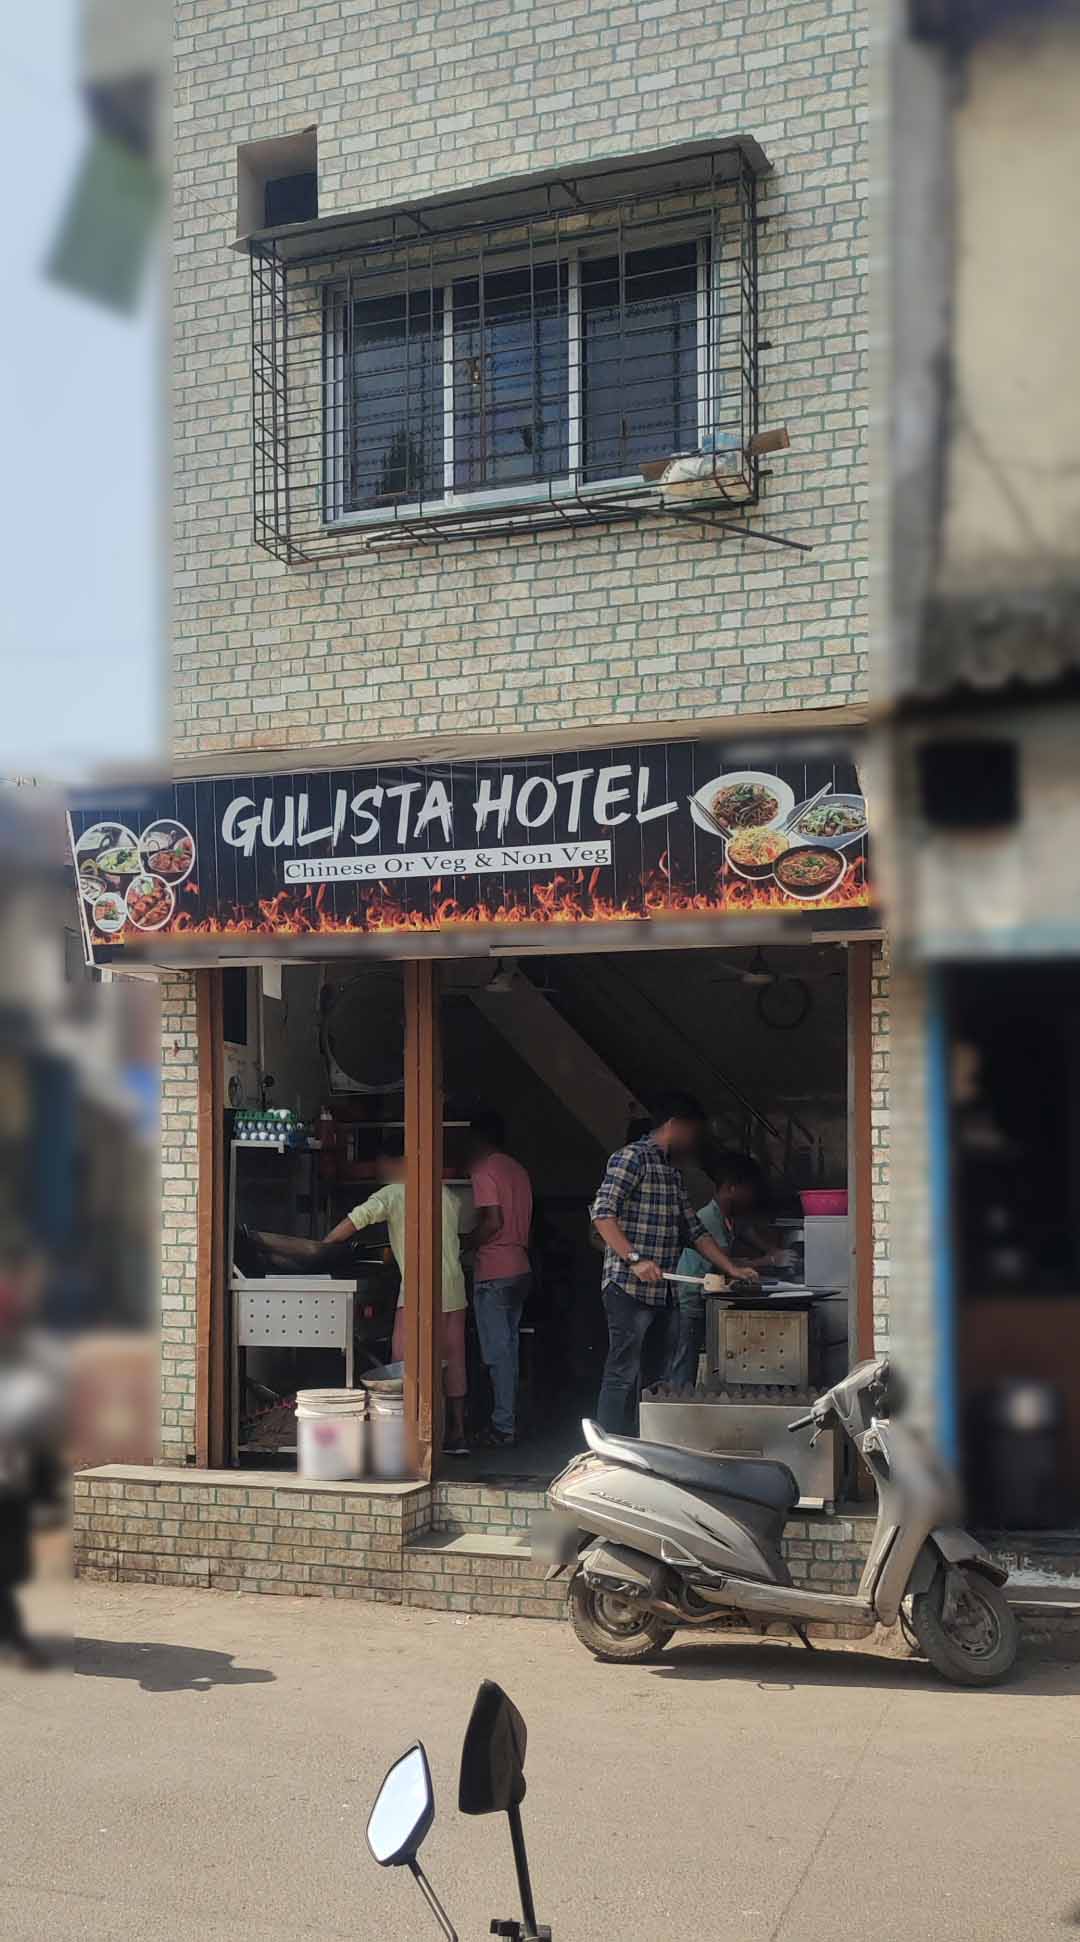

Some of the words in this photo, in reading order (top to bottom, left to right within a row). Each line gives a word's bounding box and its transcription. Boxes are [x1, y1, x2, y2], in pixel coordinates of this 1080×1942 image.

[221, 780, 454, 857] GULISTA
[472, 765, 679, 839] HOTEL
[286, 862, 376, 878] Chinese
[384, 858, 415, 873] Or
[422, 855, 467, 873] Veg
[474, 853, 493, 868] &
[501, 851, 552, 866] Non
[561, 847, 609, 864] Veg
